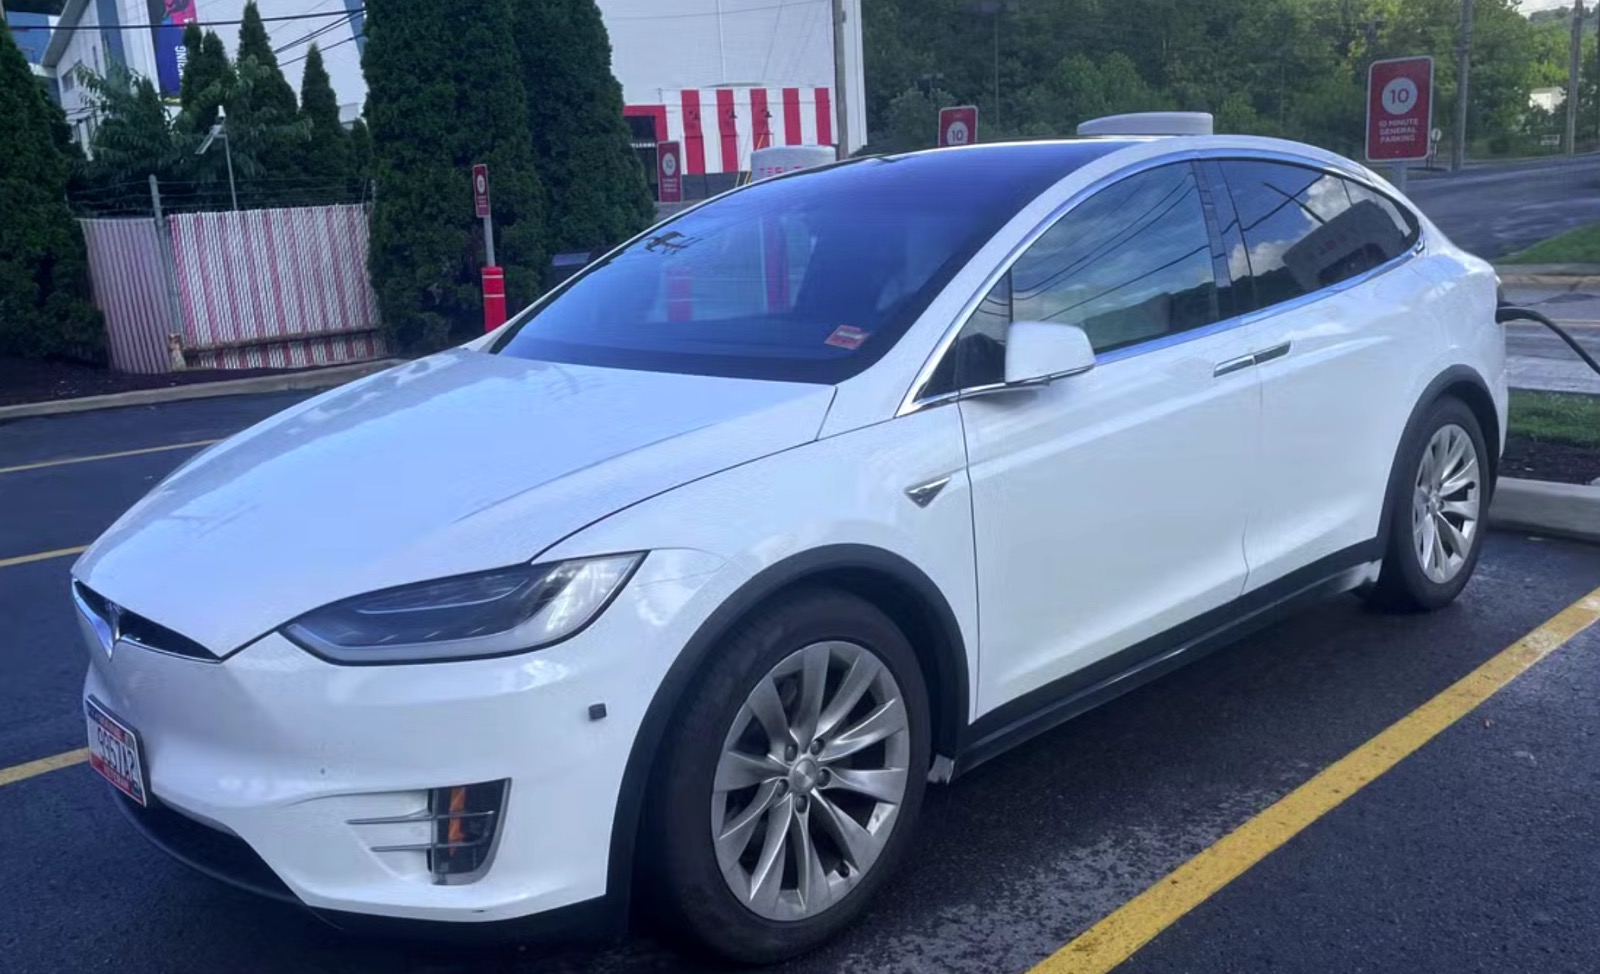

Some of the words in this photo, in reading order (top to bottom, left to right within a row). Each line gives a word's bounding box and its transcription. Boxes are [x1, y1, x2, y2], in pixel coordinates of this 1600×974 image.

[1390, 88, 1410, 105] 10
[1389, 118, 1419, 126] MINUTE
[952, 130, 964, 141] 10
[1380, 127, 1416, 135] GENERAL
[1380, 135, 1415, 144] PARKING
